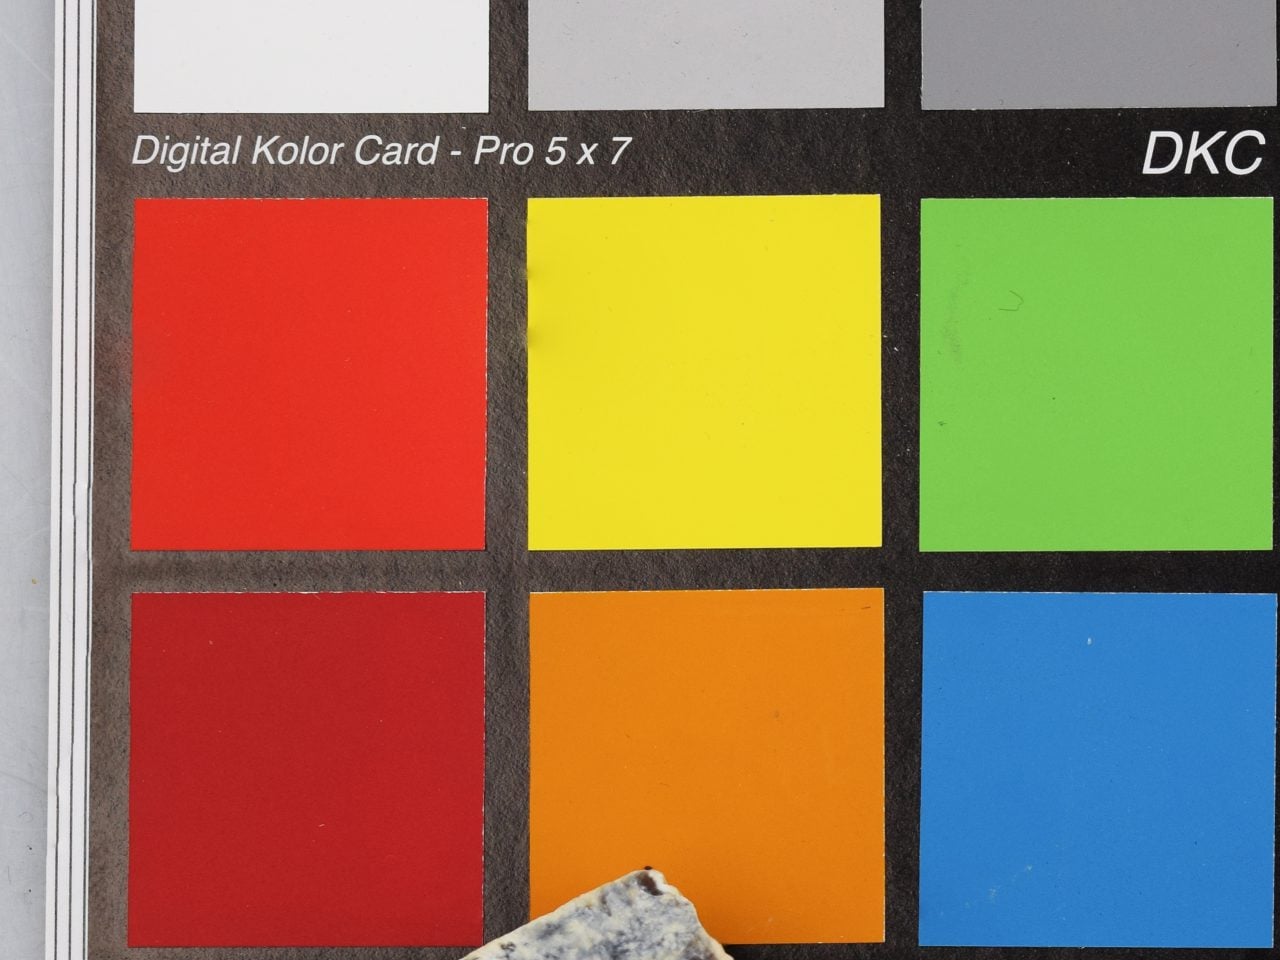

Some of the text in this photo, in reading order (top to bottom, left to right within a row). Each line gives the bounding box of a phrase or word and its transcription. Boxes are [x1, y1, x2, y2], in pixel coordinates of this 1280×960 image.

[131, 134, 242, 174] Digital
[251, 135, 346, 166] Kolor
[354, 135, 441, 166] Card
[473, 136, 534, 166] Pro
[544, 136, 568, 166] 5
[575, 143, 599, 165] x
[611, 136, 633, 165] 7
[1142, 129, 1266, 176] DKC
